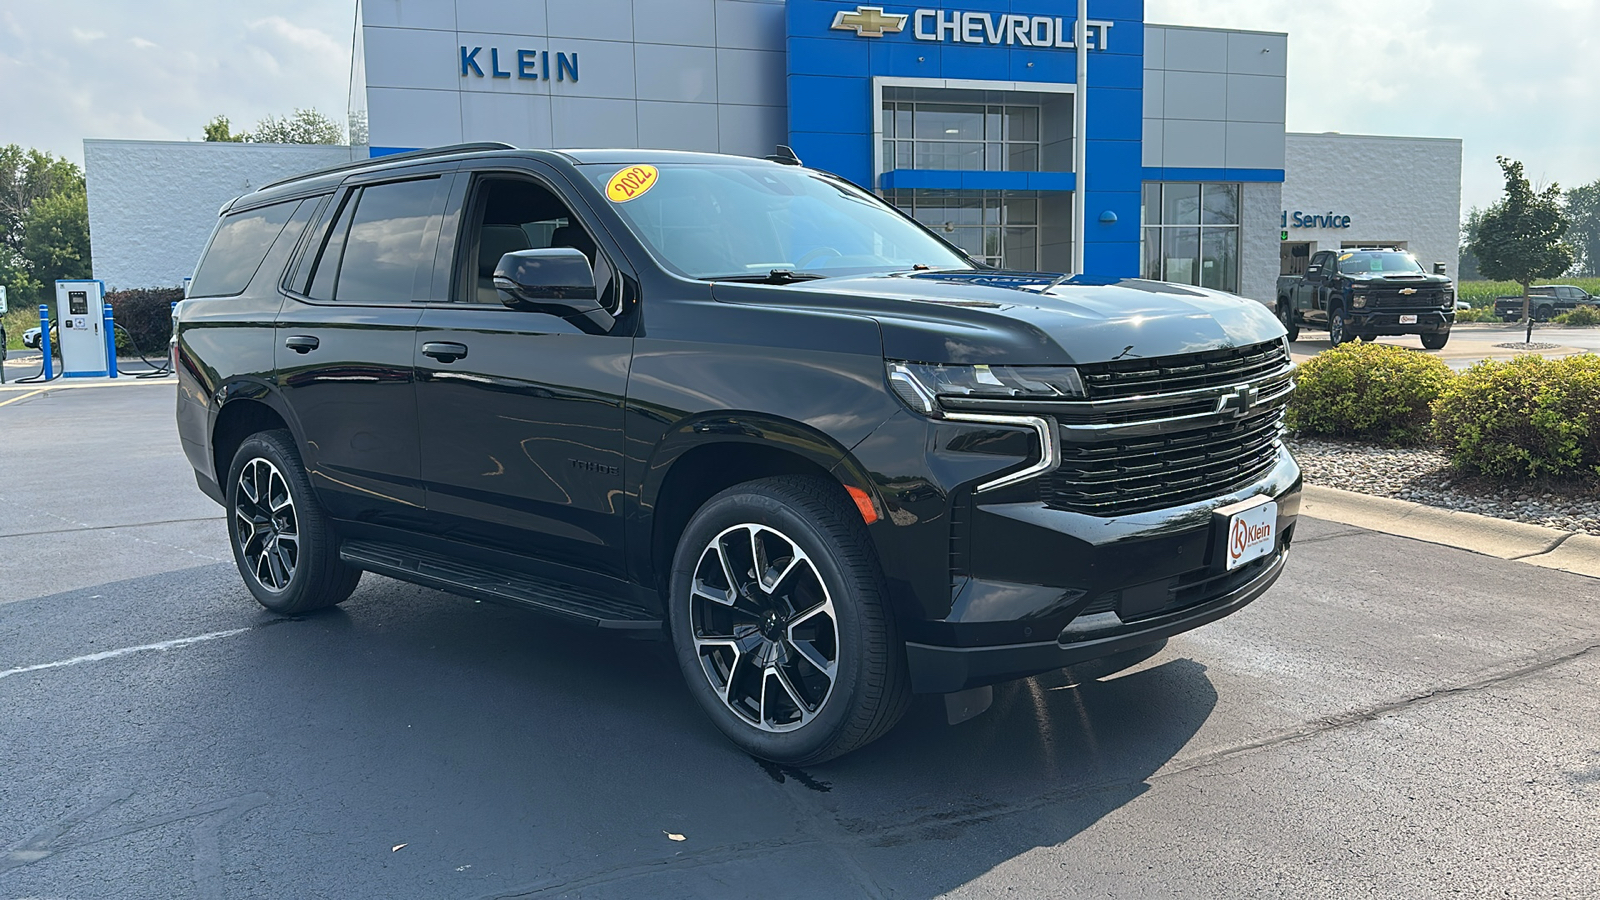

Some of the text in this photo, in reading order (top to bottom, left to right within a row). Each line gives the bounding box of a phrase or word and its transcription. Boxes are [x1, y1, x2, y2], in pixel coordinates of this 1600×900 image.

[914, 9, 1114, 50] CHEVROLET
[460, 46, 579, 82] KLEIN
[614, 167, 653, 197] 2022
[1292, 211, 1351, 229] Service
[567, 457, 620, 477] TAHOE
[1247, 521, 1271, 544] Klein
